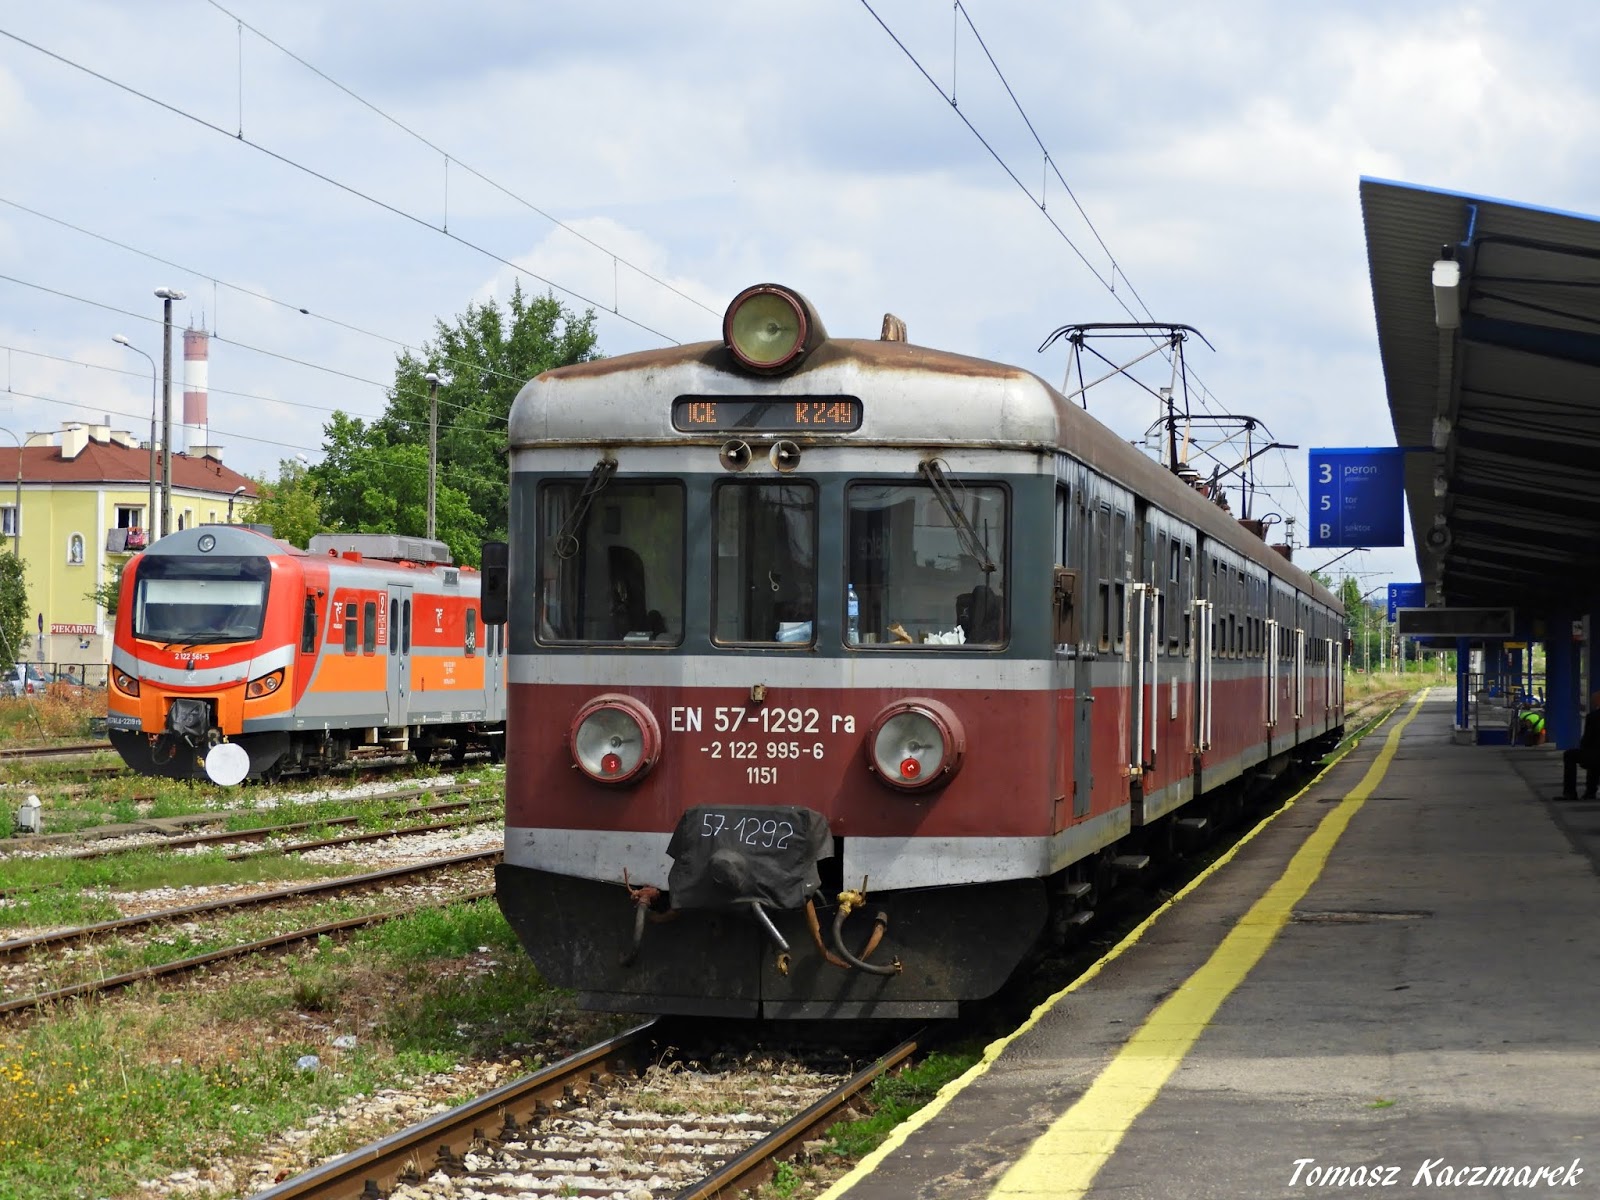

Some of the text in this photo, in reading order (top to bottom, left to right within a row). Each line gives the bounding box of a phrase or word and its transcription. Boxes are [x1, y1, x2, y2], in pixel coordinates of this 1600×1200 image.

[1318, 463, 1333, 484] 3
[1344, 465, 1377, 477] peron
[1320, 495, 1358, 511] 5 tor
[1320, 523, 1331, 539] B
[1391, 588, 1397, 598] 3
[51, 624, 97, 634] PIEKARNIA
[174, 652, 180, 660] 2
[180, 652, 191, 660] 122
[671, 706, 856, 733] EN 57-1292 ra
[728, 741, 758, 759] 122
[766, 742, 825, 760] 995-6
[746, 766, 778, 784] 1151
[701, 813, 794, 850] 57-1292
